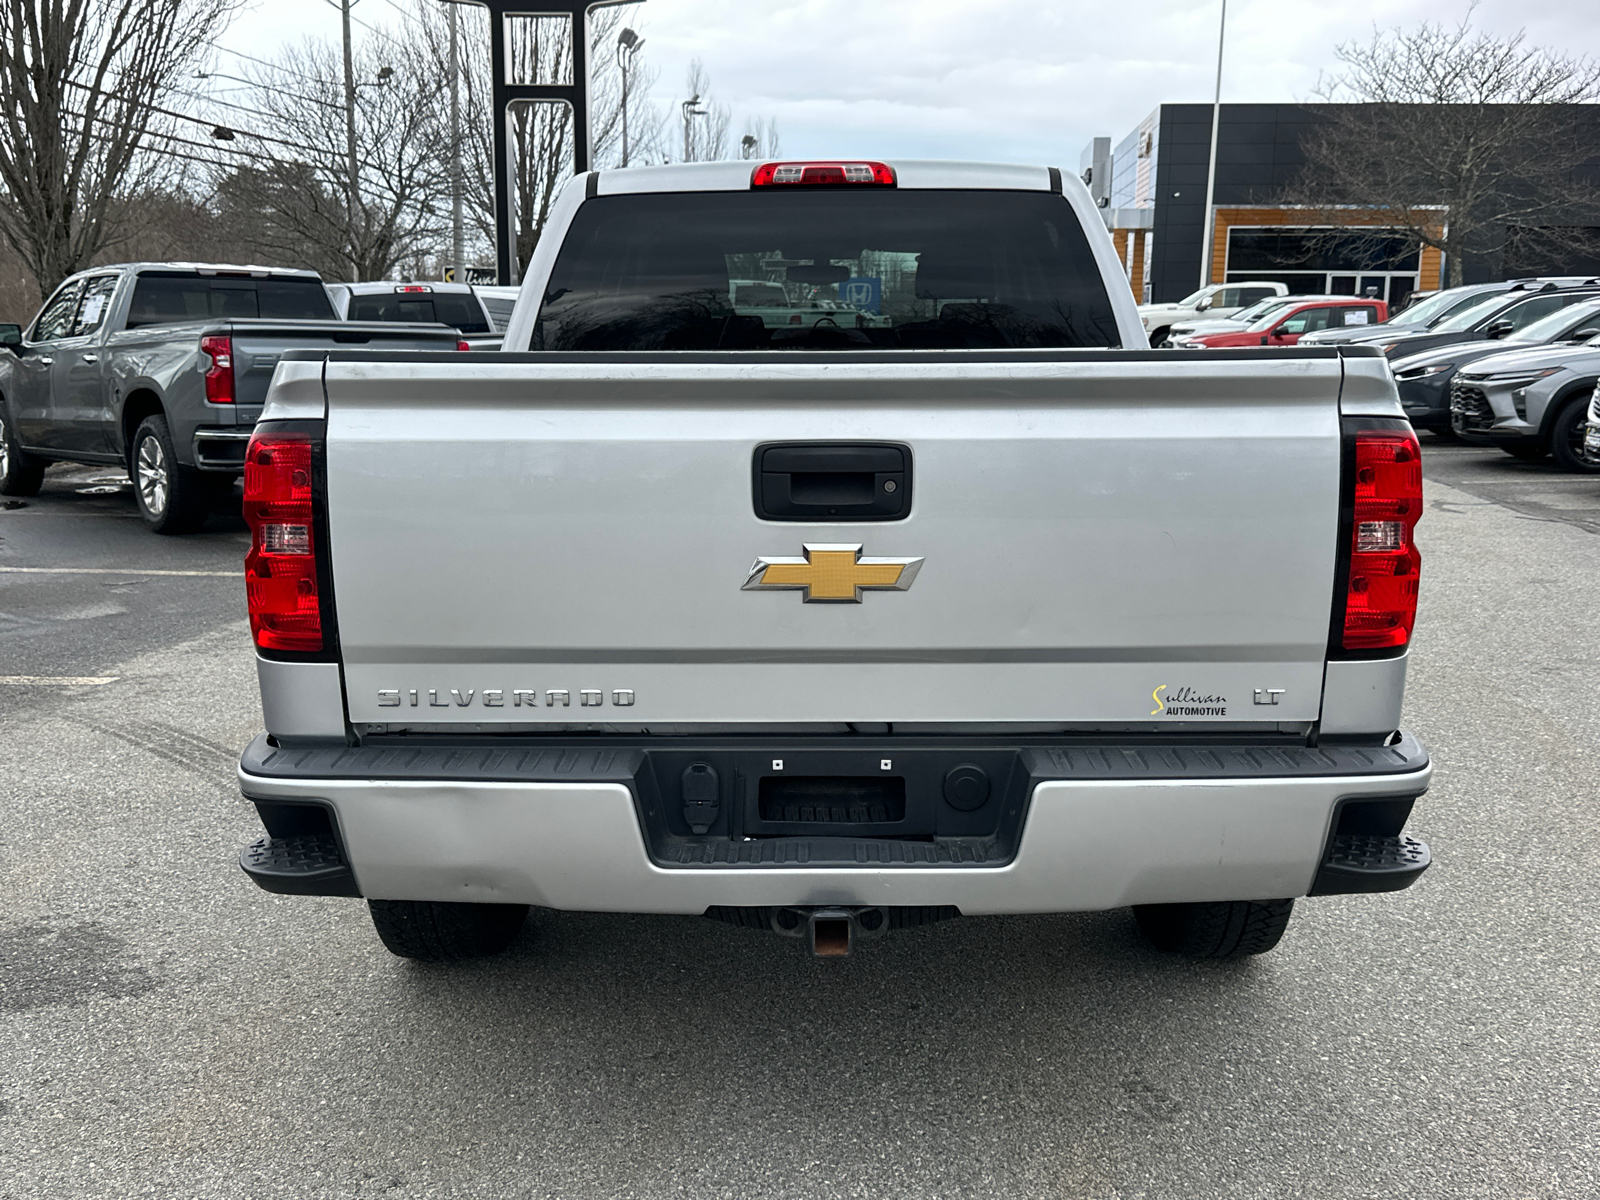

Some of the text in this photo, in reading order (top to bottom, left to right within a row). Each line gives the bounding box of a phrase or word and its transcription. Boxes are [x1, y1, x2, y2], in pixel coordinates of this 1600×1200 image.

[377, 689, 636, 707] SILVERADO
[1151, 684, 1227, 715] Sullivan
[1253, 688, 1286, 705] LT
[1165, 706, 1227, 716] AUTOMOTIVE
